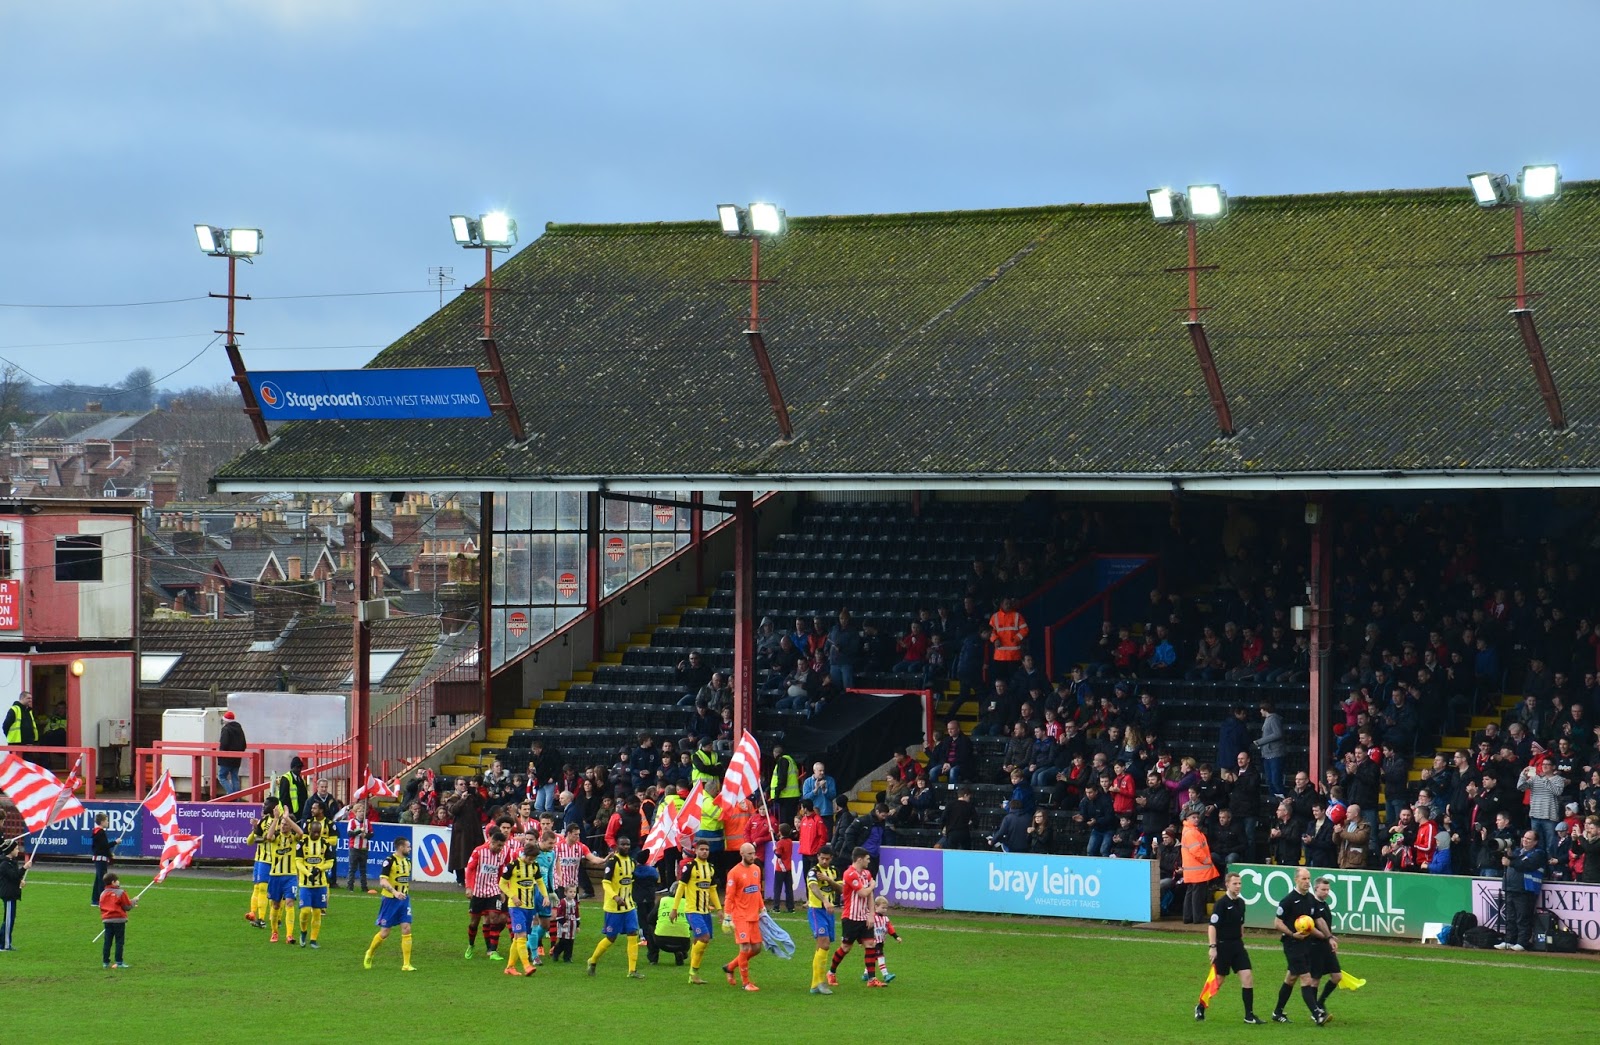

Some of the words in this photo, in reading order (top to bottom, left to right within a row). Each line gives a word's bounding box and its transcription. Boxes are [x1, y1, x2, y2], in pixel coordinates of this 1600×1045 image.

[286, 391, 362, 411] Stagecoach
[362, 395, 393, 406] SOUTH
[393, 394, 418, 406] WEST
[420, 394, 449, 405] FAMILY
[450, 393, 480, 405] STAND
[178, 807, 200, 818] Exeter
[201, 808, 235, 820] Southgate
[236, 809, 256, 819] Hotel
[48, 837, 68, 846] 340130
[213, 834, 248, 844] Mercure
[988, 862, 1039, 901] bray
[1043, 864, 1101, 897] leino
[1237, 868, 1406, 915] COSTAL
[1034, 898, 1071, 907] WHATEVER
[1071, 899, 1078, 907] IT
[1079, 900, 1101, 908] TAKES
[1541, 889, 1600, 912] EXET
